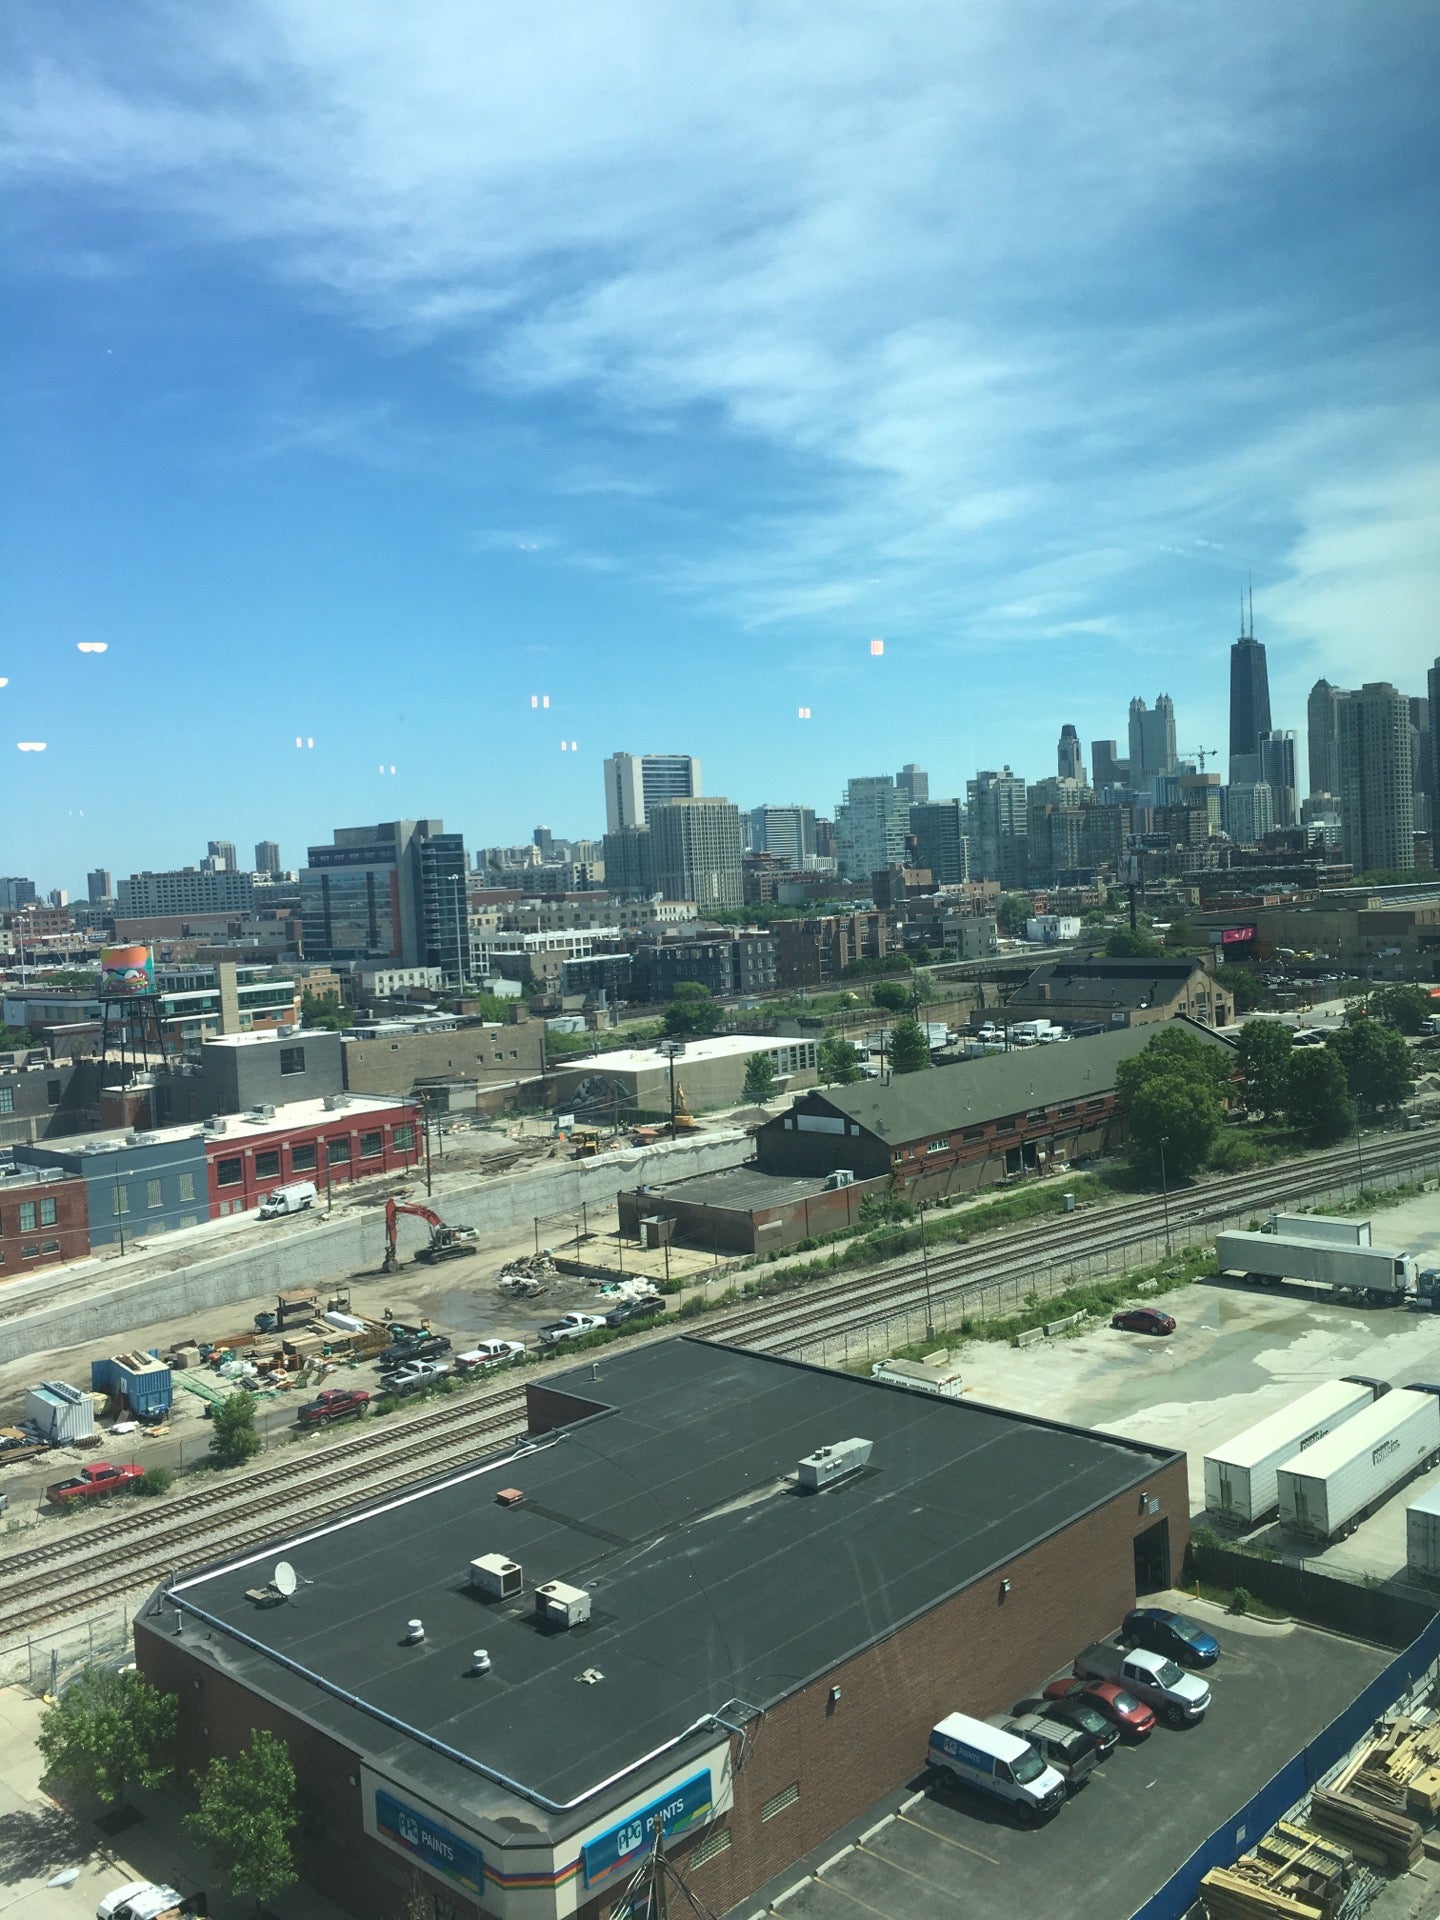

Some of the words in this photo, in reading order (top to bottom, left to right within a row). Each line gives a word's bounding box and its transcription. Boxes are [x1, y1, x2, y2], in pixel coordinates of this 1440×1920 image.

[421, 1830, 454, 1861] PAINTS
[618, 1821, 642, 1854] PPG
[646, 1798, 684, 1833] PNTS
